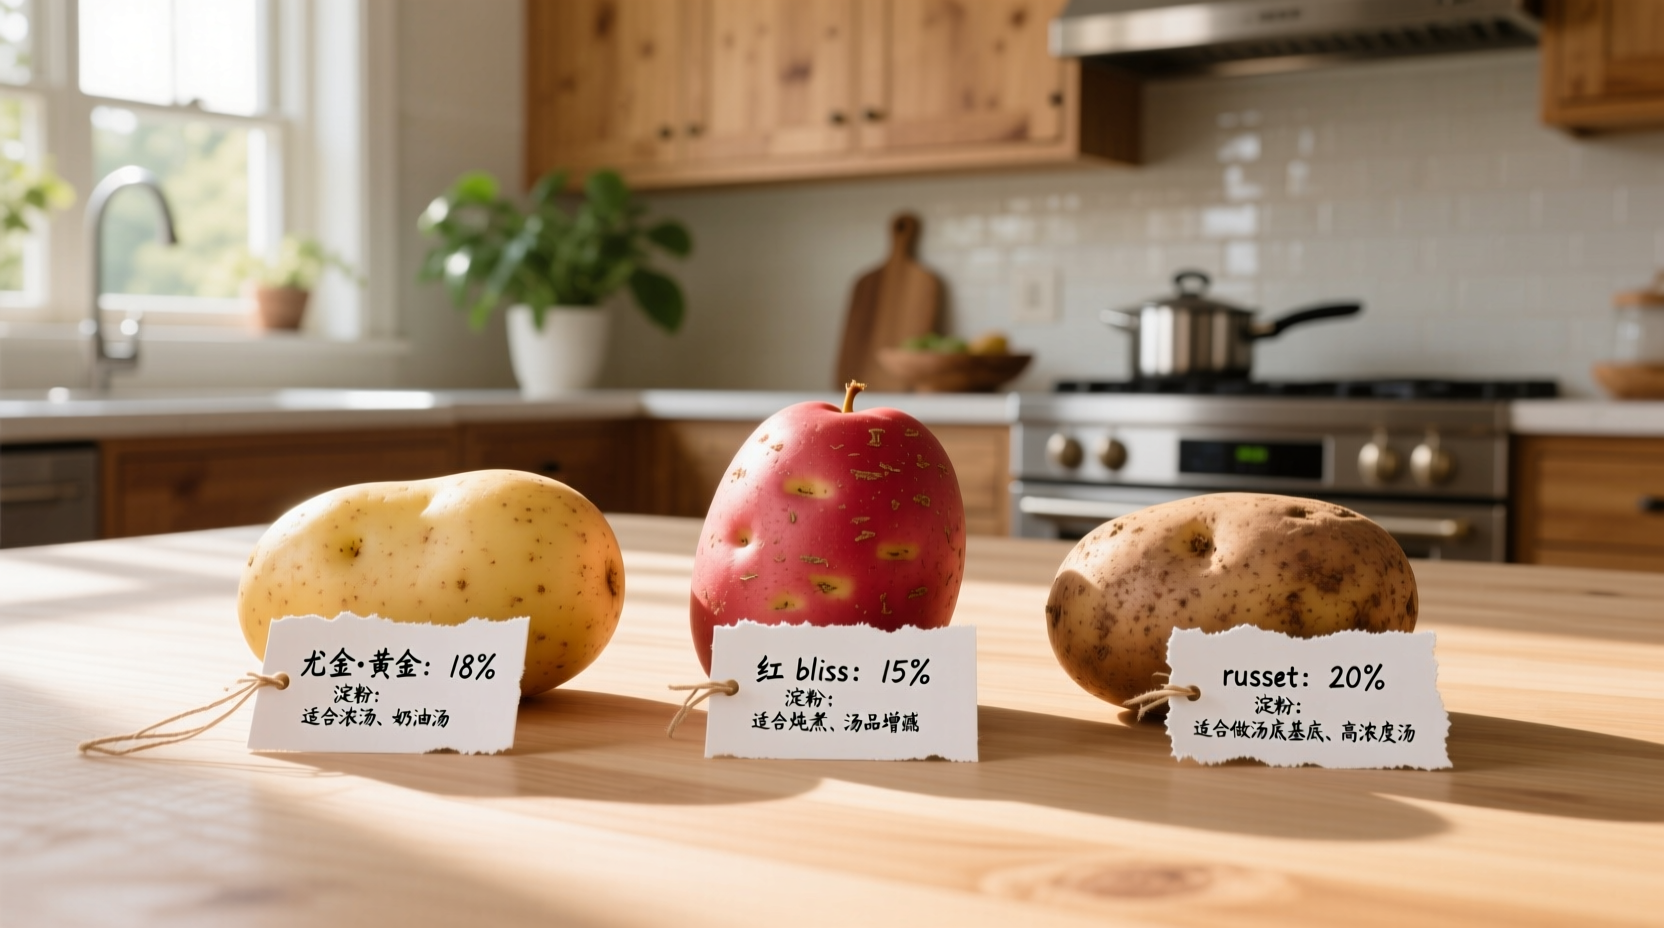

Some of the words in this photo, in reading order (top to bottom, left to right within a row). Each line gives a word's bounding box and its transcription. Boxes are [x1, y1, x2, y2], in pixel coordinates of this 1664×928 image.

[449, 652, 497, 681] 18%
[755, 654, 785, 683] 红
[795, 656, 860, 683] bliss:
[881, 658, 931, 687] 15%
[1223, 665, 1309, 689] russet:
[1328, 663, 1386, 692] 20%
[300, 706, 450, 729] 适合浓汤、奶油汤
[1193, 718, 1416, 744] 适合做汤底基底、高浓度汤
